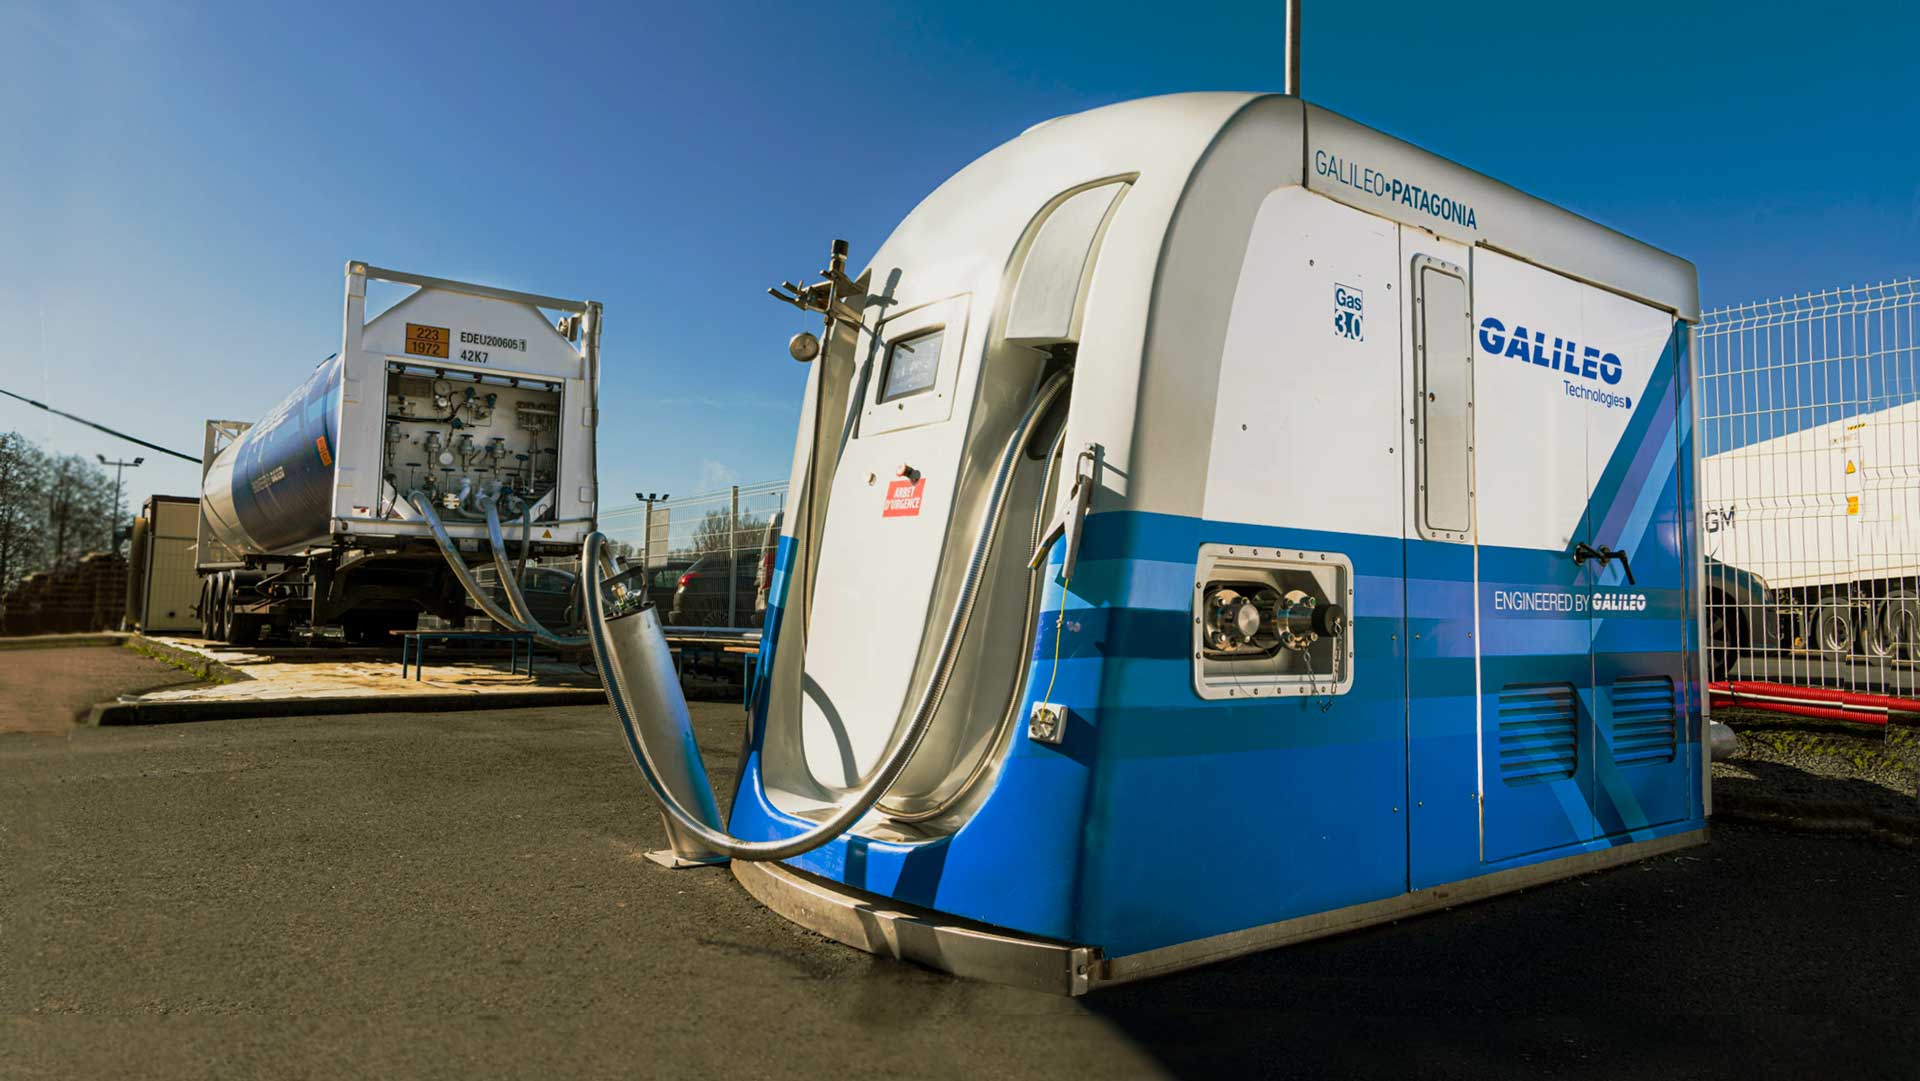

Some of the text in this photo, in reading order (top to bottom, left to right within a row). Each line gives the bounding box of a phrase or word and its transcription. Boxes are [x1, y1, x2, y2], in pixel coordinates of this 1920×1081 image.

[1335, 287, 1362, 311] Gas
[416, 328, 439, 341] 223
[412, 341, 439, 355] 1972
[460, 350, 489, 364] 42K7
[1479, 317, 1622, 385] GALILEO
[1563, 380, 1625, 408] Technologies
[1495, 591, 1646, 612] ENGINEERED BY GALILEO
